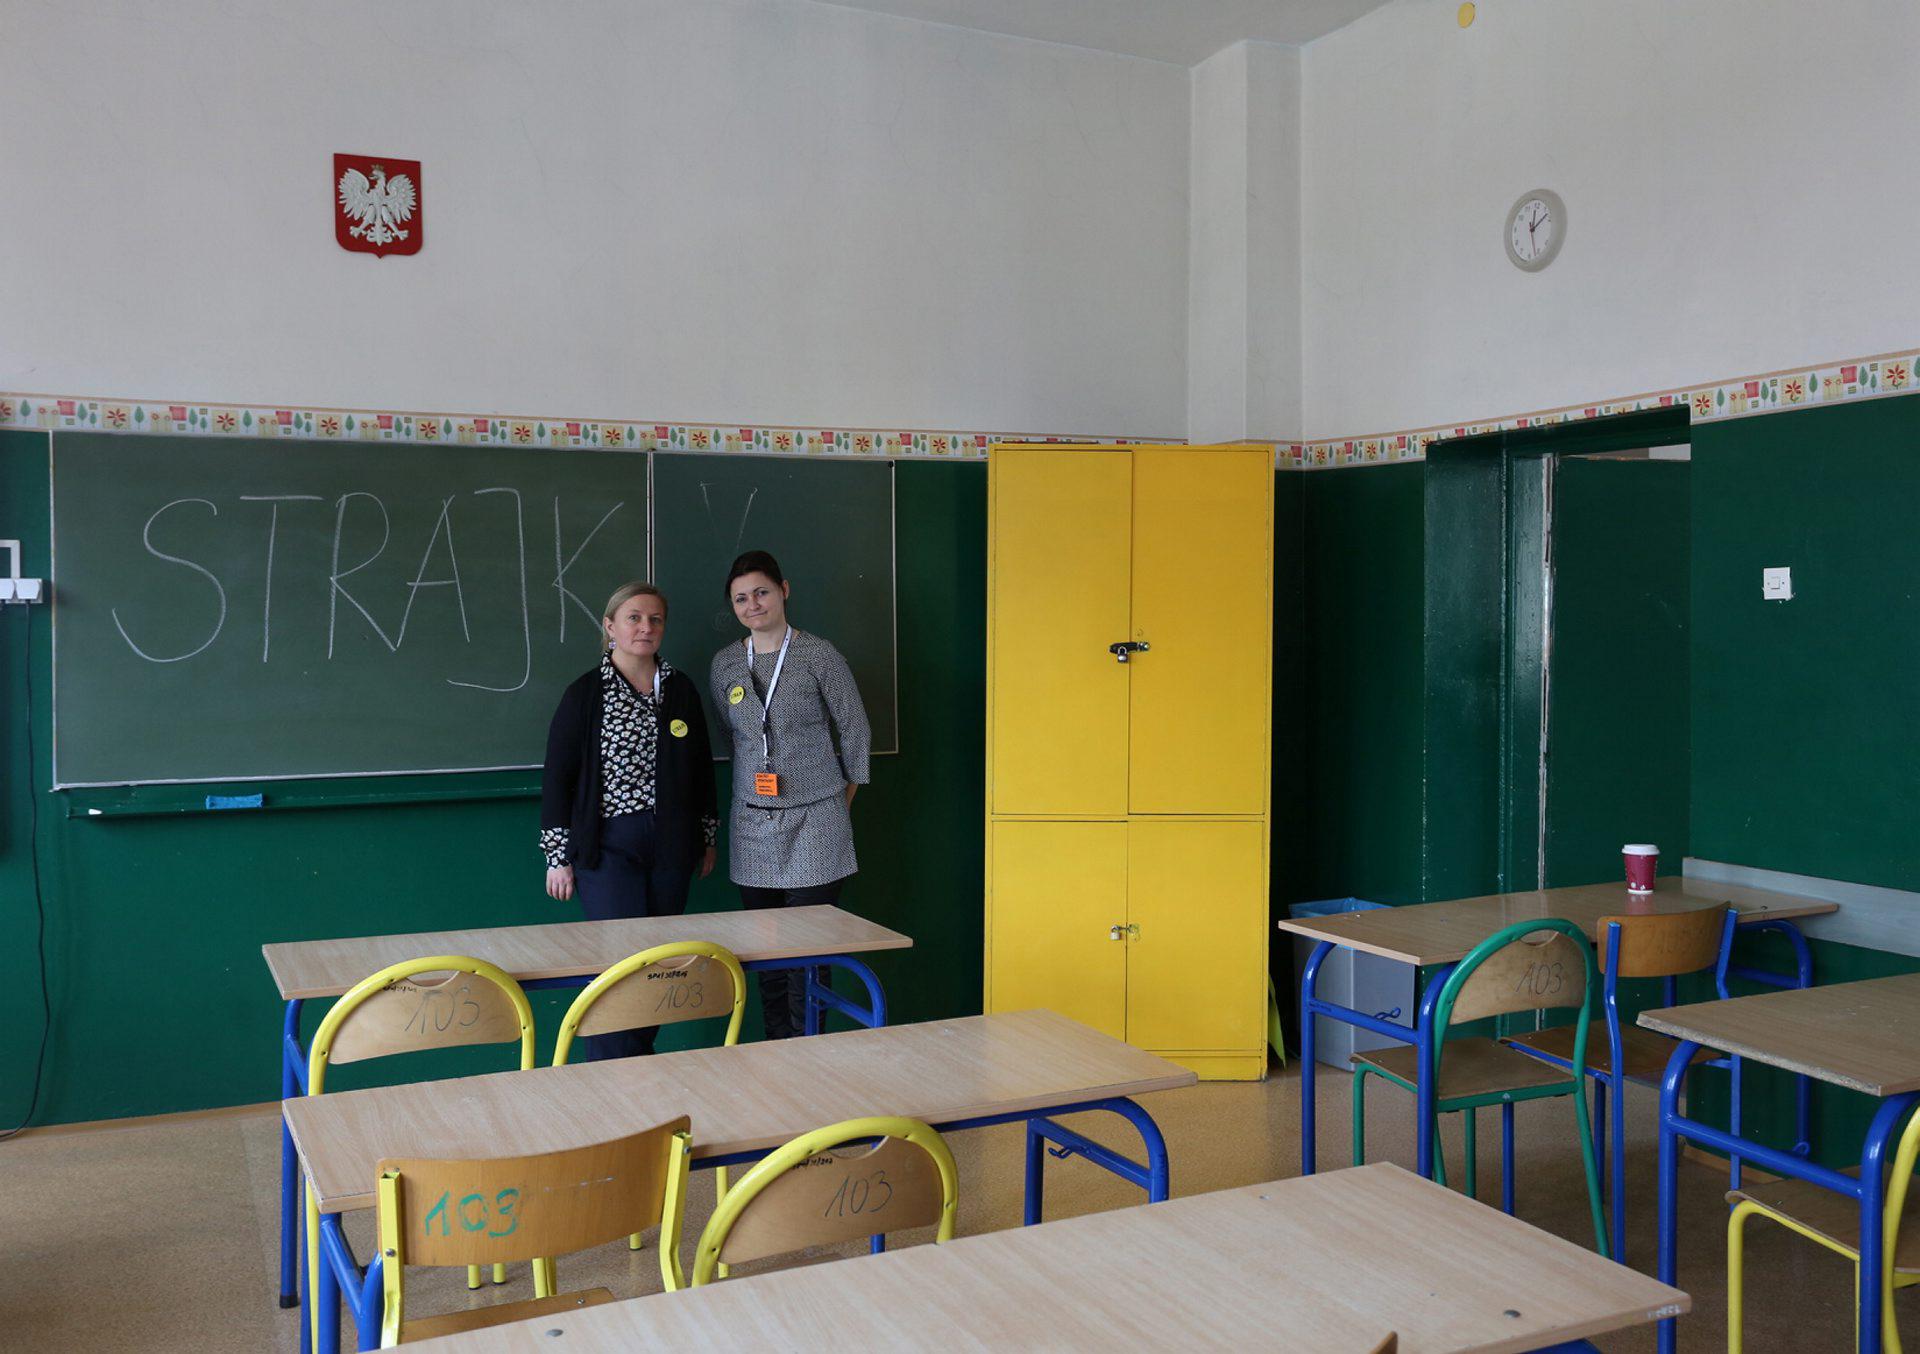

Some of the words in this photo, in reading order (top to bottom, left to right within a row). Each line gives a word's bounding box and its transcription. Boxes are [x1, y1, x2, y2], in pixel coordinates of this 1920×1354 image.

[112, 487, 625, 693] STRAJK
[653, 981, 704, 1013] 103
[1515, 961, 1563, 1000] 103
[403, 984, 480, 1035] 103
[424, 1187, 520, 1238] 103
[824, 1169, 893, 1217] 103
